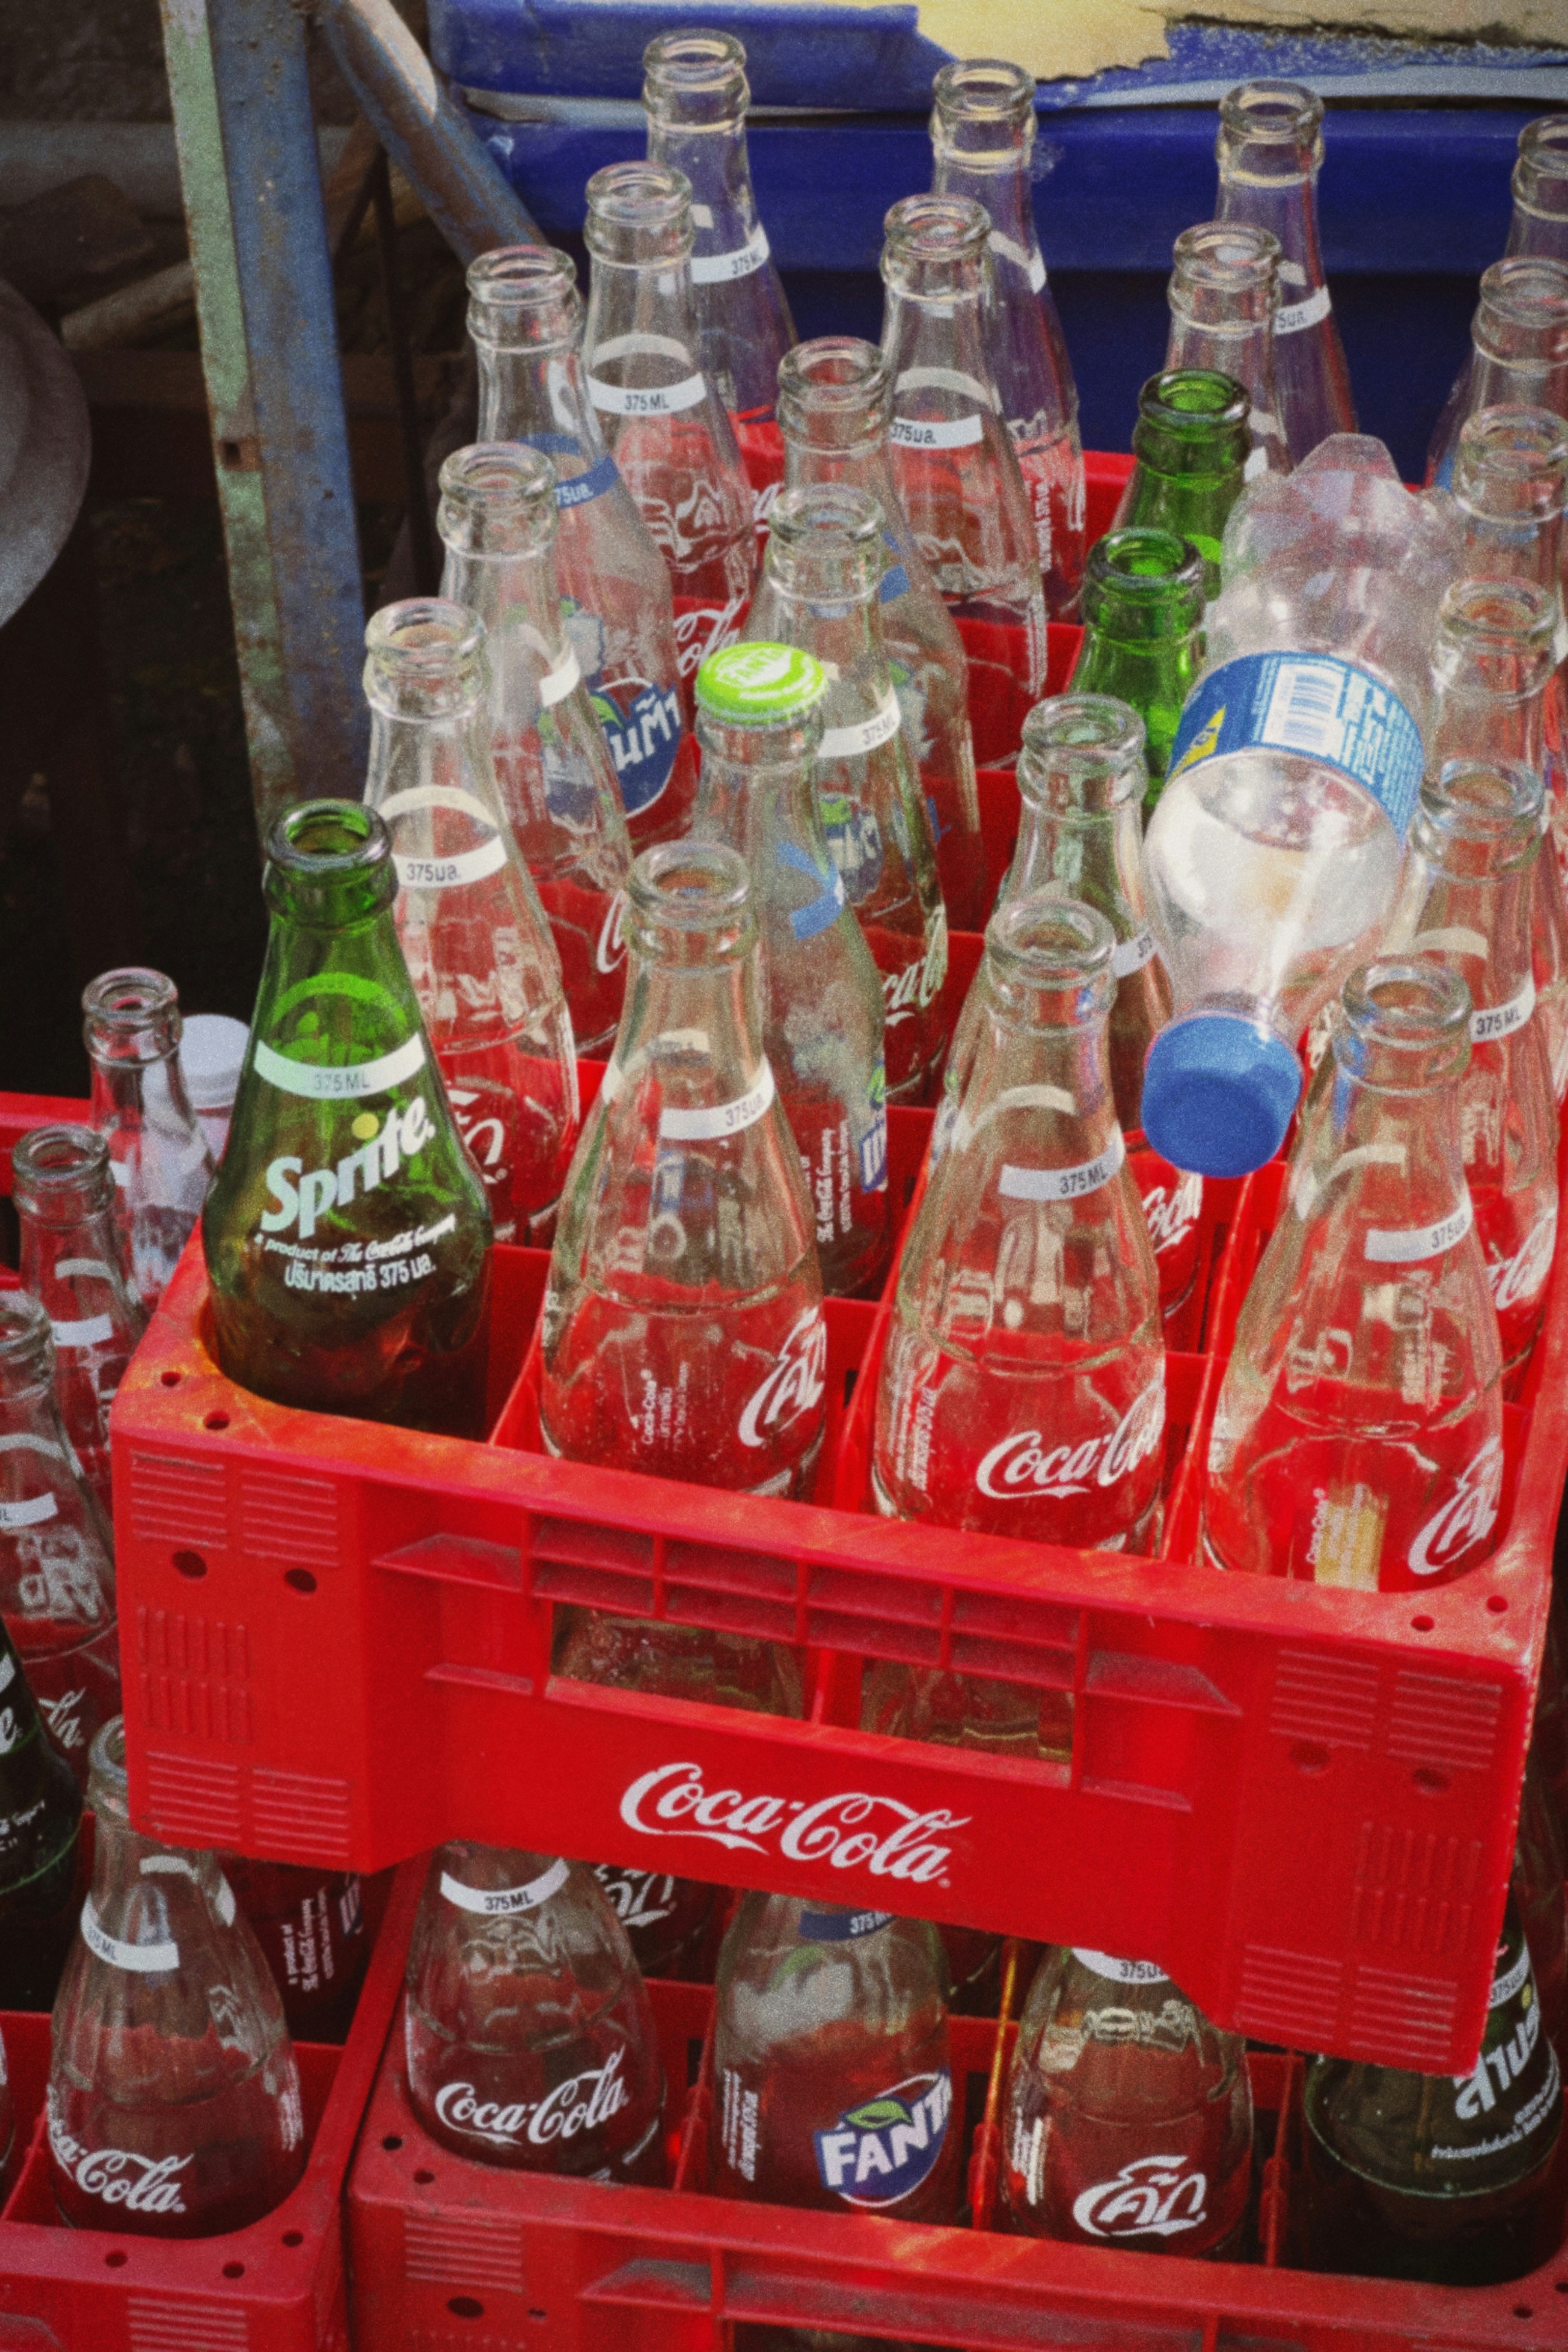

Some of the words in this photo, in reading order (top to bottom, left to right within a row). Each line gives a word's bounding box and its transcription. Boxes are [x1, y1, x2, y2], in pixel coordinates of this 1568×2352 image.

[261, 1096, 436, 1240] Sprite
[620, 1762, 972, 1883] Coca-Cola
[485, 1891, 533, 1911] 375ML
[435, 2043, 626, 2145] Coca-Cola
